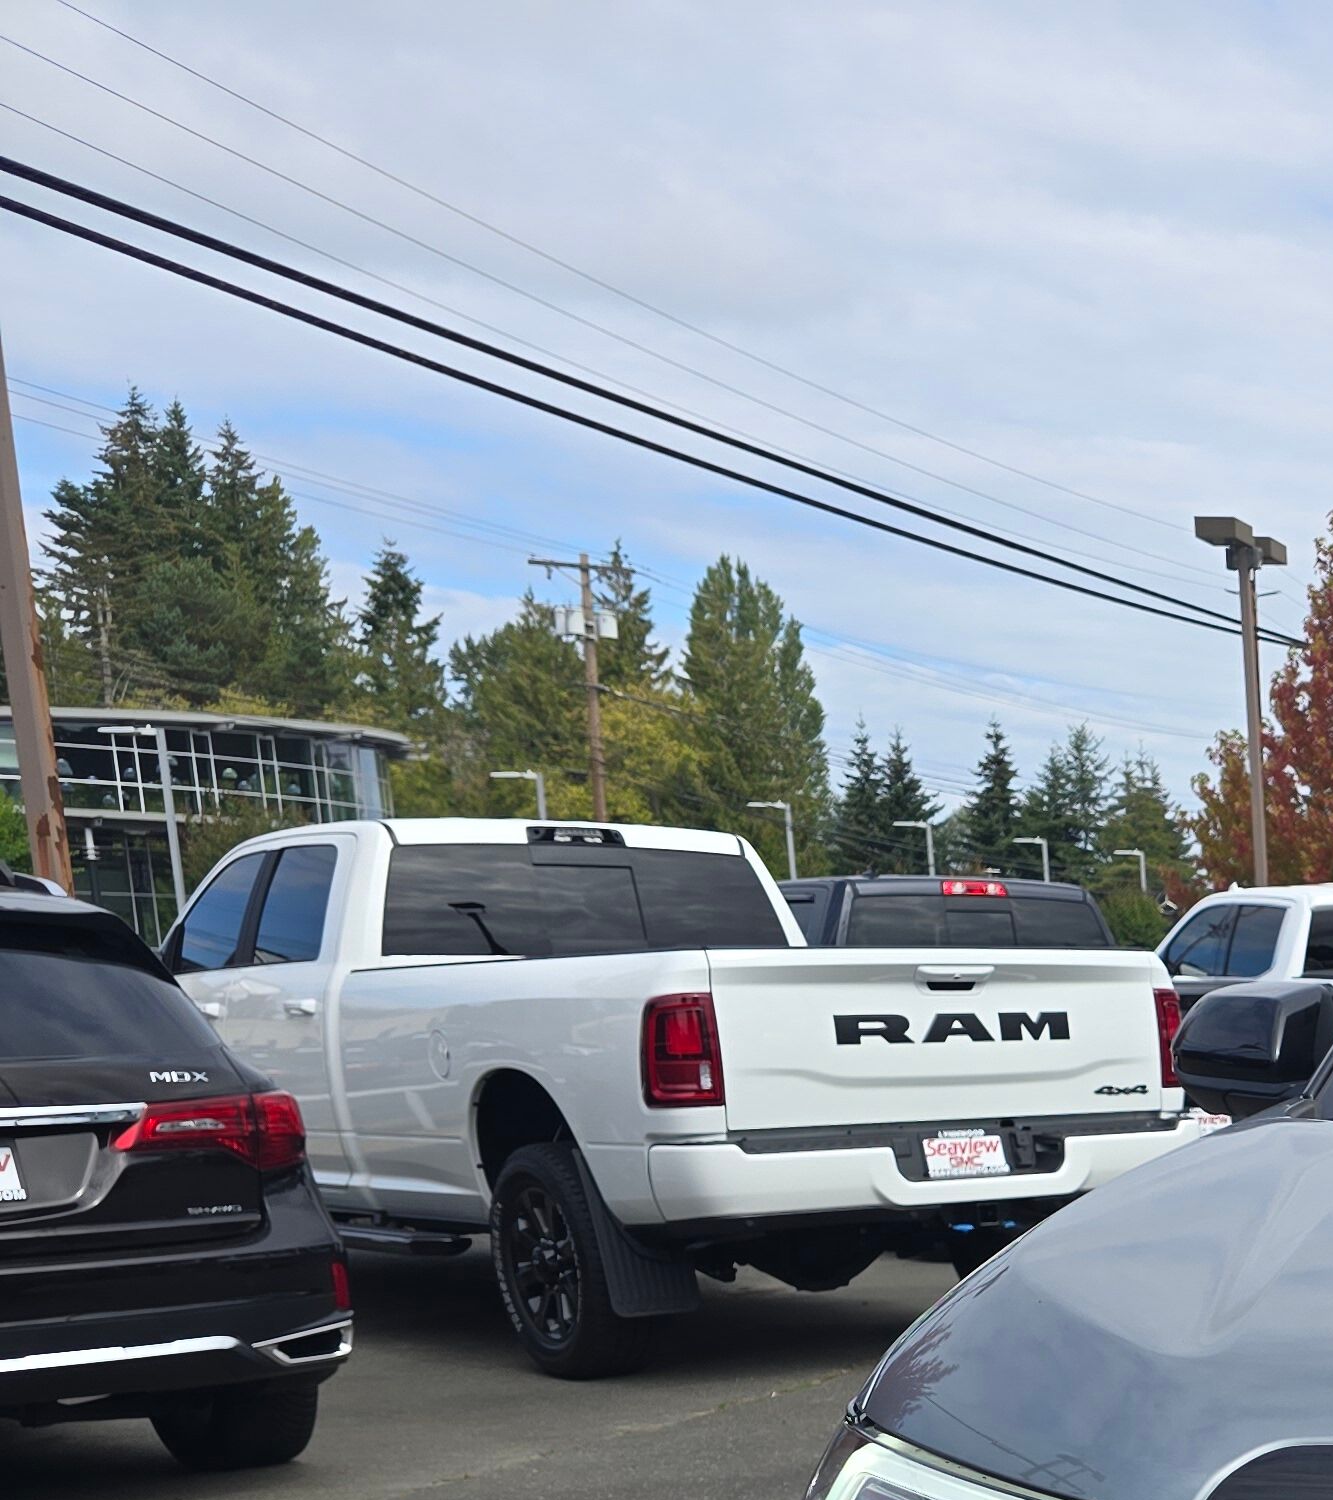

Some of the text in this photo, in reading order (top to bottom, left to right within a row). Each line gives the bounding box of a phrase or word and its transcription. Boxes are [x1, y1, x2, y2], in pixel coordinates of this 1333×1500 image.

[833, 1011, 1071, 1045] RAM
[149, 1071, 209, 1083] MDX
[926, 1138, 1000, 1157] Seaview
